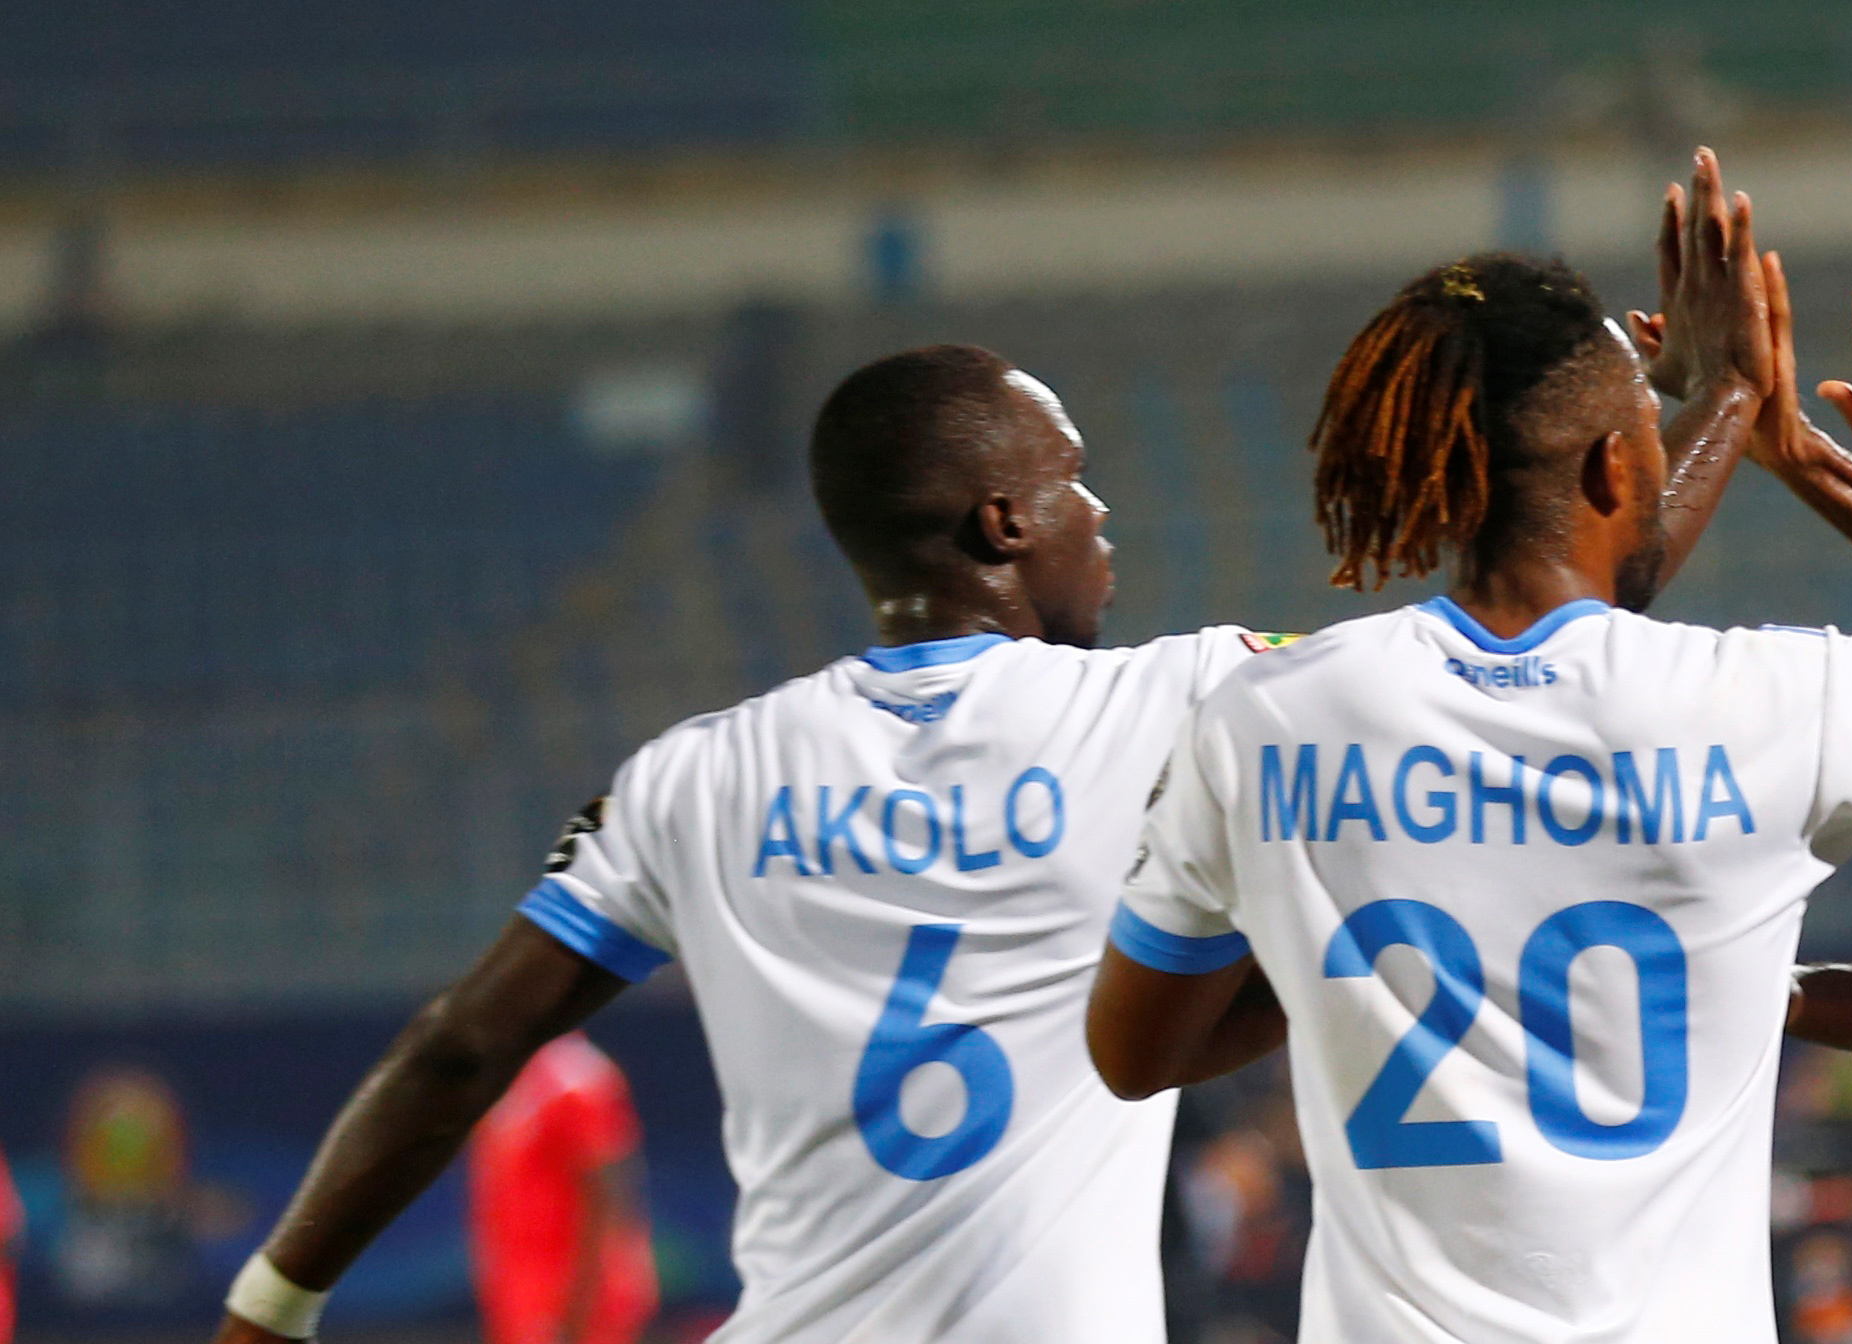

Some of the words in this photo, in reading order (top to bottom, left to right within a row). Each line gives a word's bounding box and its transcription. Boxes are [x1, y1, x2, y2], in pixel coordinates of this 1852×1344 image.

[752, 766, 1064, 878] AKOLO
[1260, 743, 1755, 847] MAGHOMA
[851, 922, 1015, 1183] 6
[1323, 898, 1689, 1171] 20
